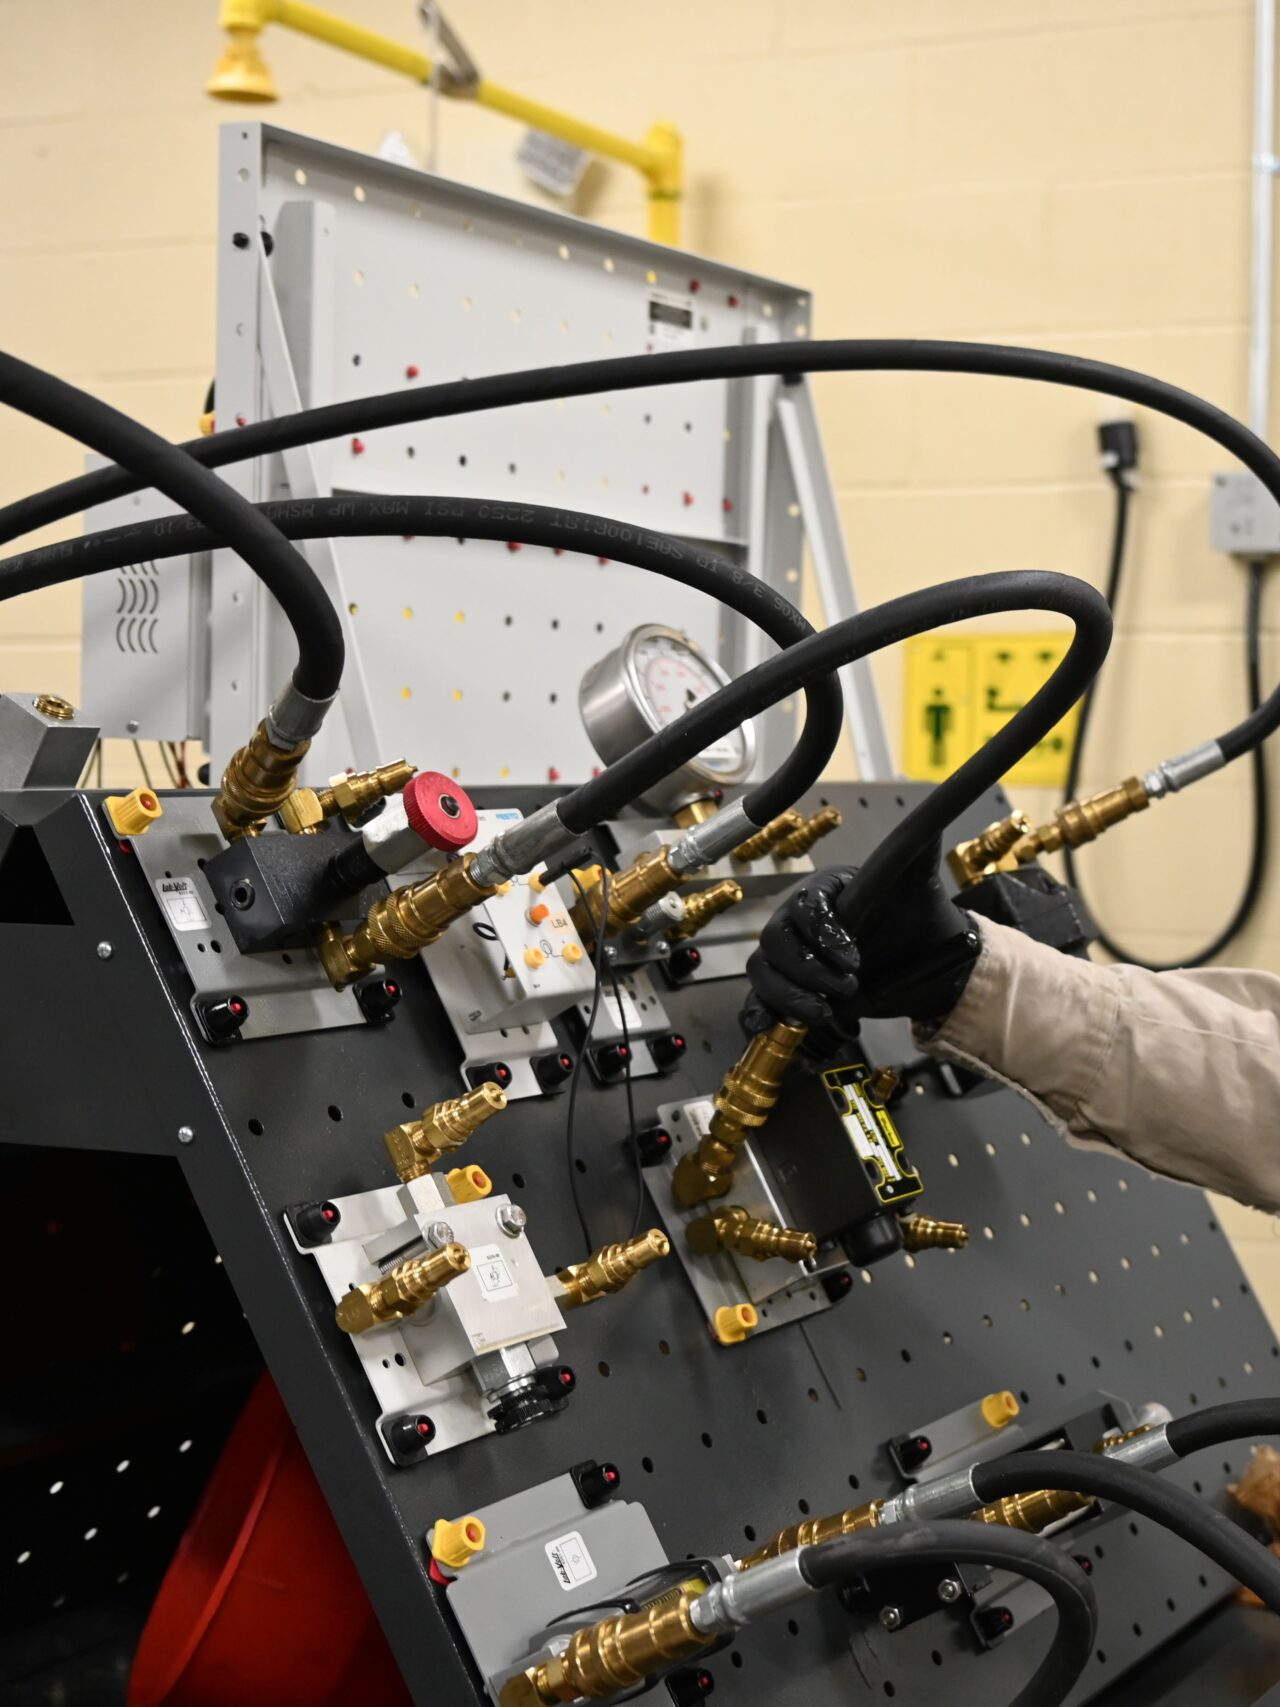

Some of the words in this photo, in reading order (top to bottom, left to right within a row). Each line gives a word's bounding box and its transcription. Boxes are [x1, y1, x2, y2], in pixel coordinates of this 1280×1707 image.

[368, 501, 411, 516] MAX
[732, 571, 766, 598] 3/8
[551, 918, 569, 929] LB4
